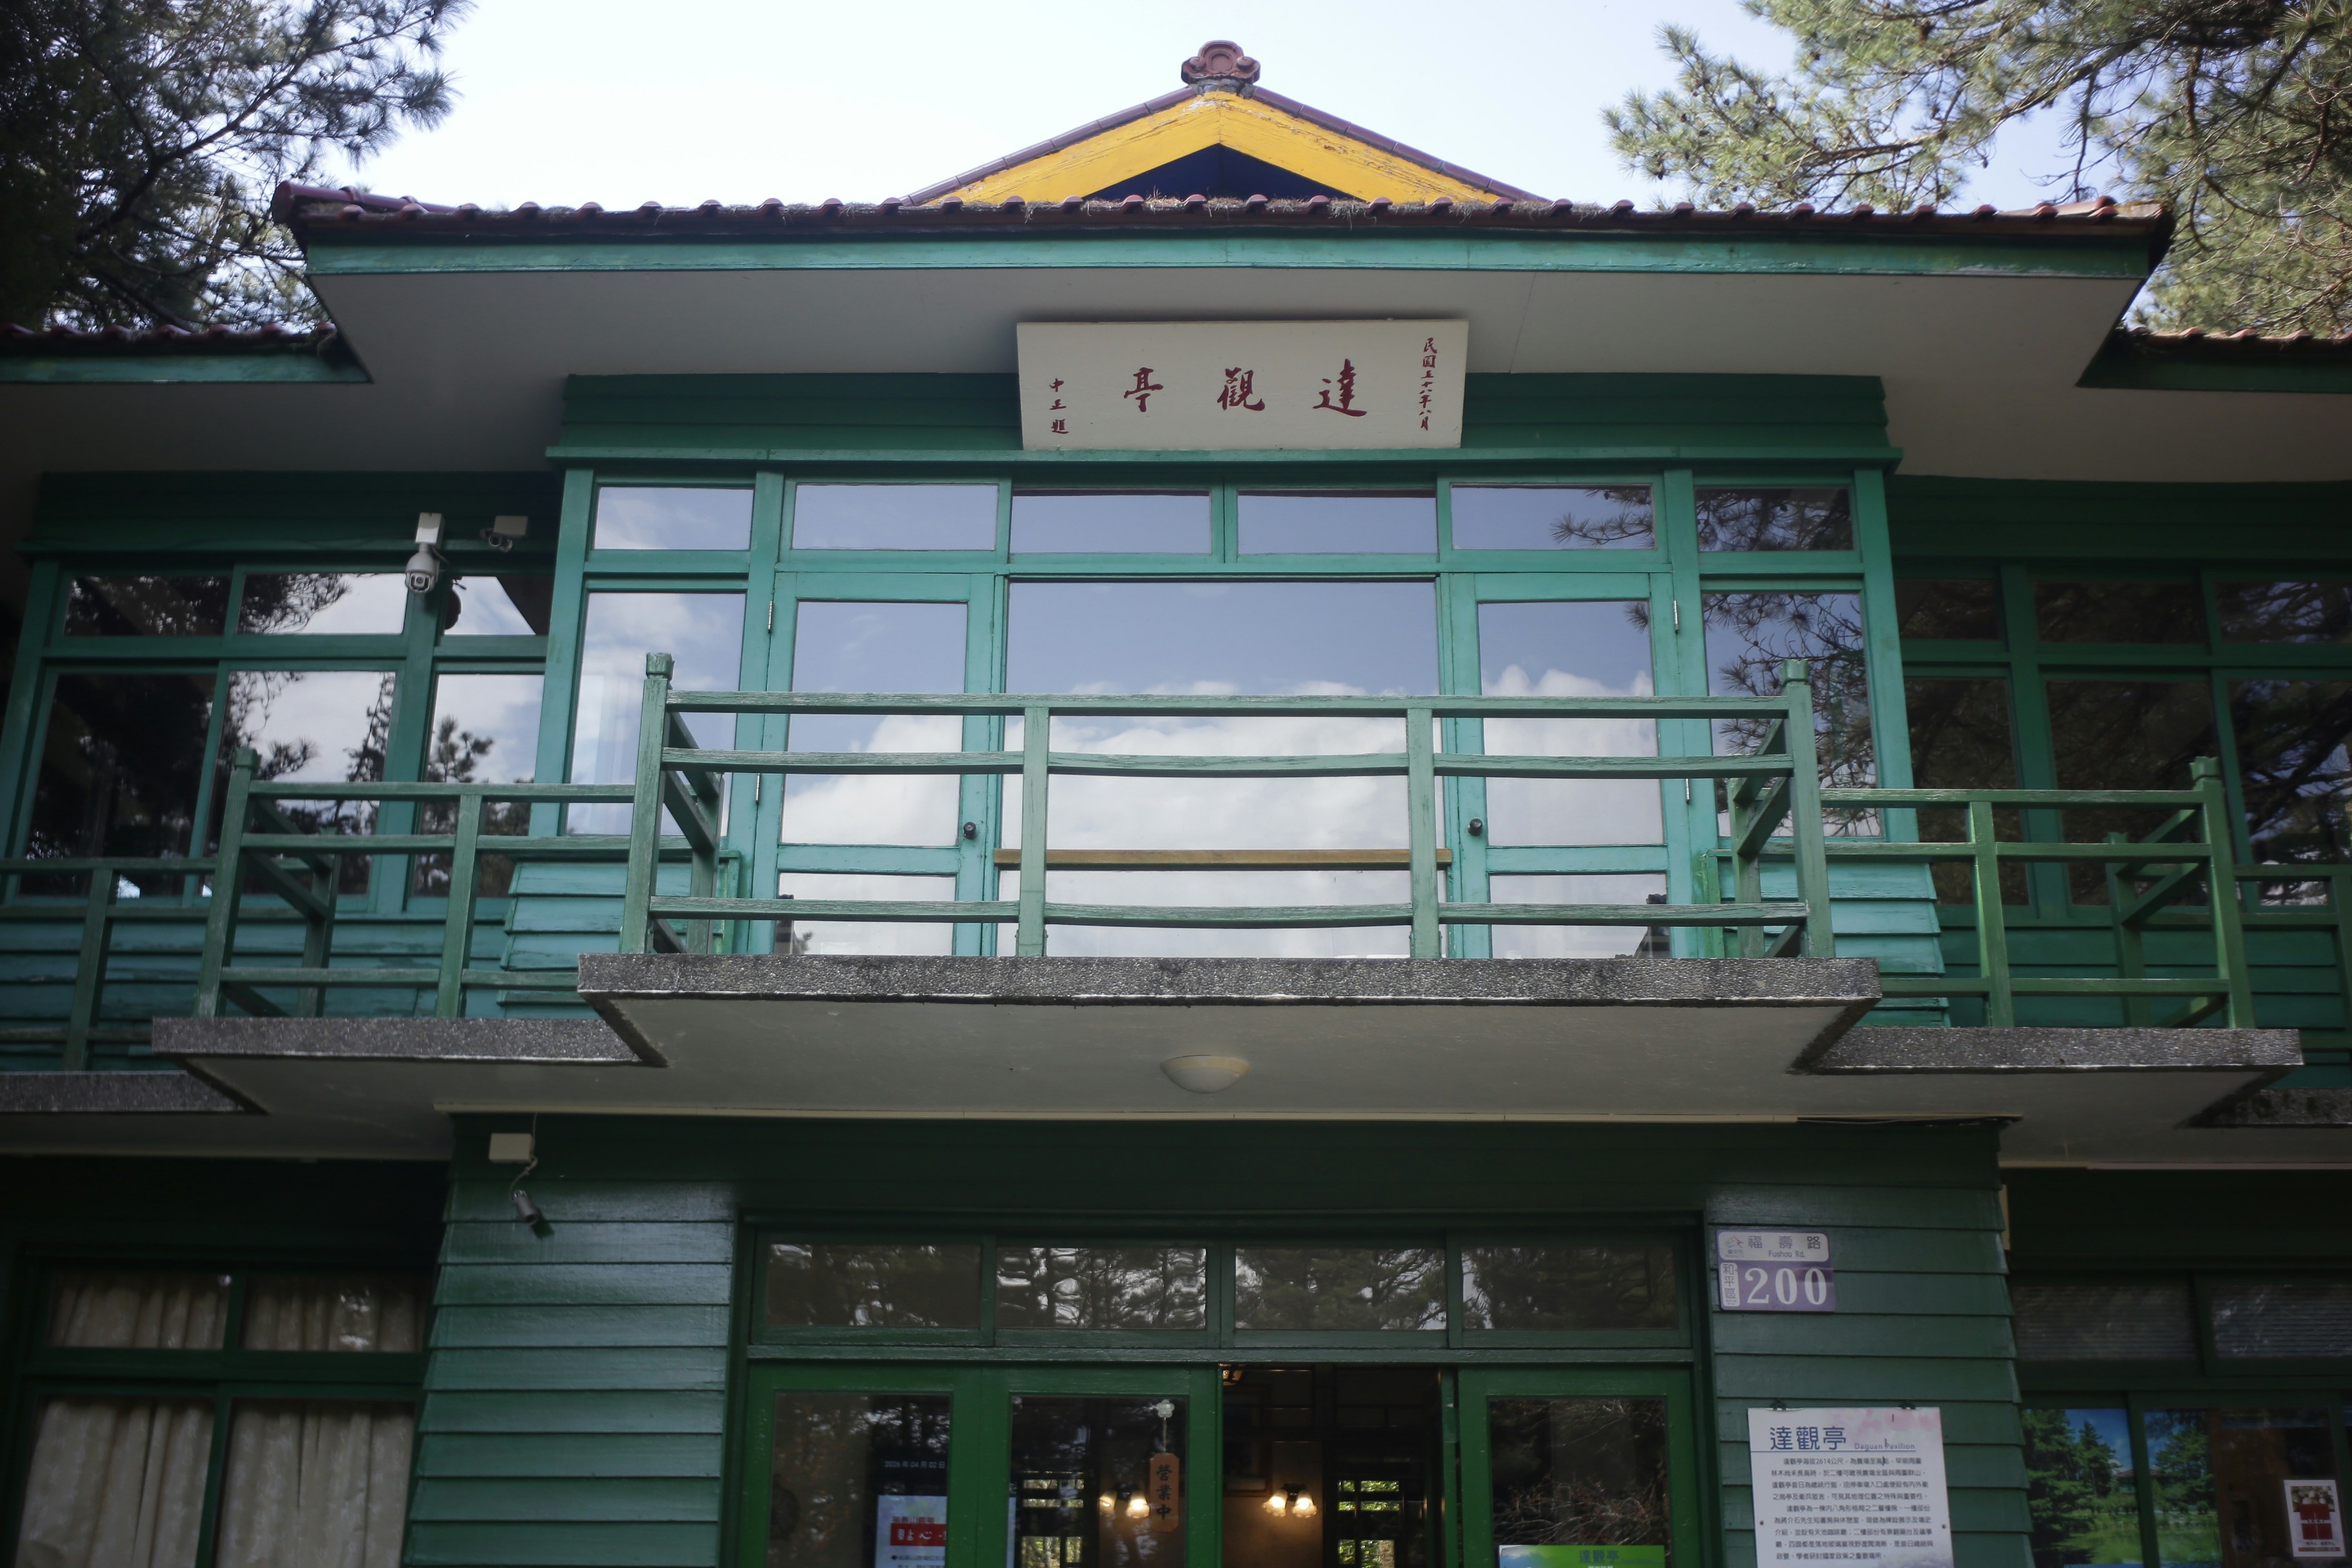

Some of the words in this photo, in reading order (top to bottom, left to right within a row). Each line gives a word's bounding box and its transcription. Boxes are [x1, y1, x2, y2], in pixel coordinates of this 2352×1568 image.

[1124, 358, 1367, 418] 達觀亭
[1048, 378, 1070, 435] 中正題
[1748, 1235, 1821, 1249] 福壽路
[1723, 1263, 1736, 1299] 和平區
[1745, 1268, 1827, 1305] 200
[1770, 1426, 1847, 1450] 達觀亭
[1854, 1443, 1883, 1451] Daguan
[1156, 1464, 1173, 1521] 營業中
